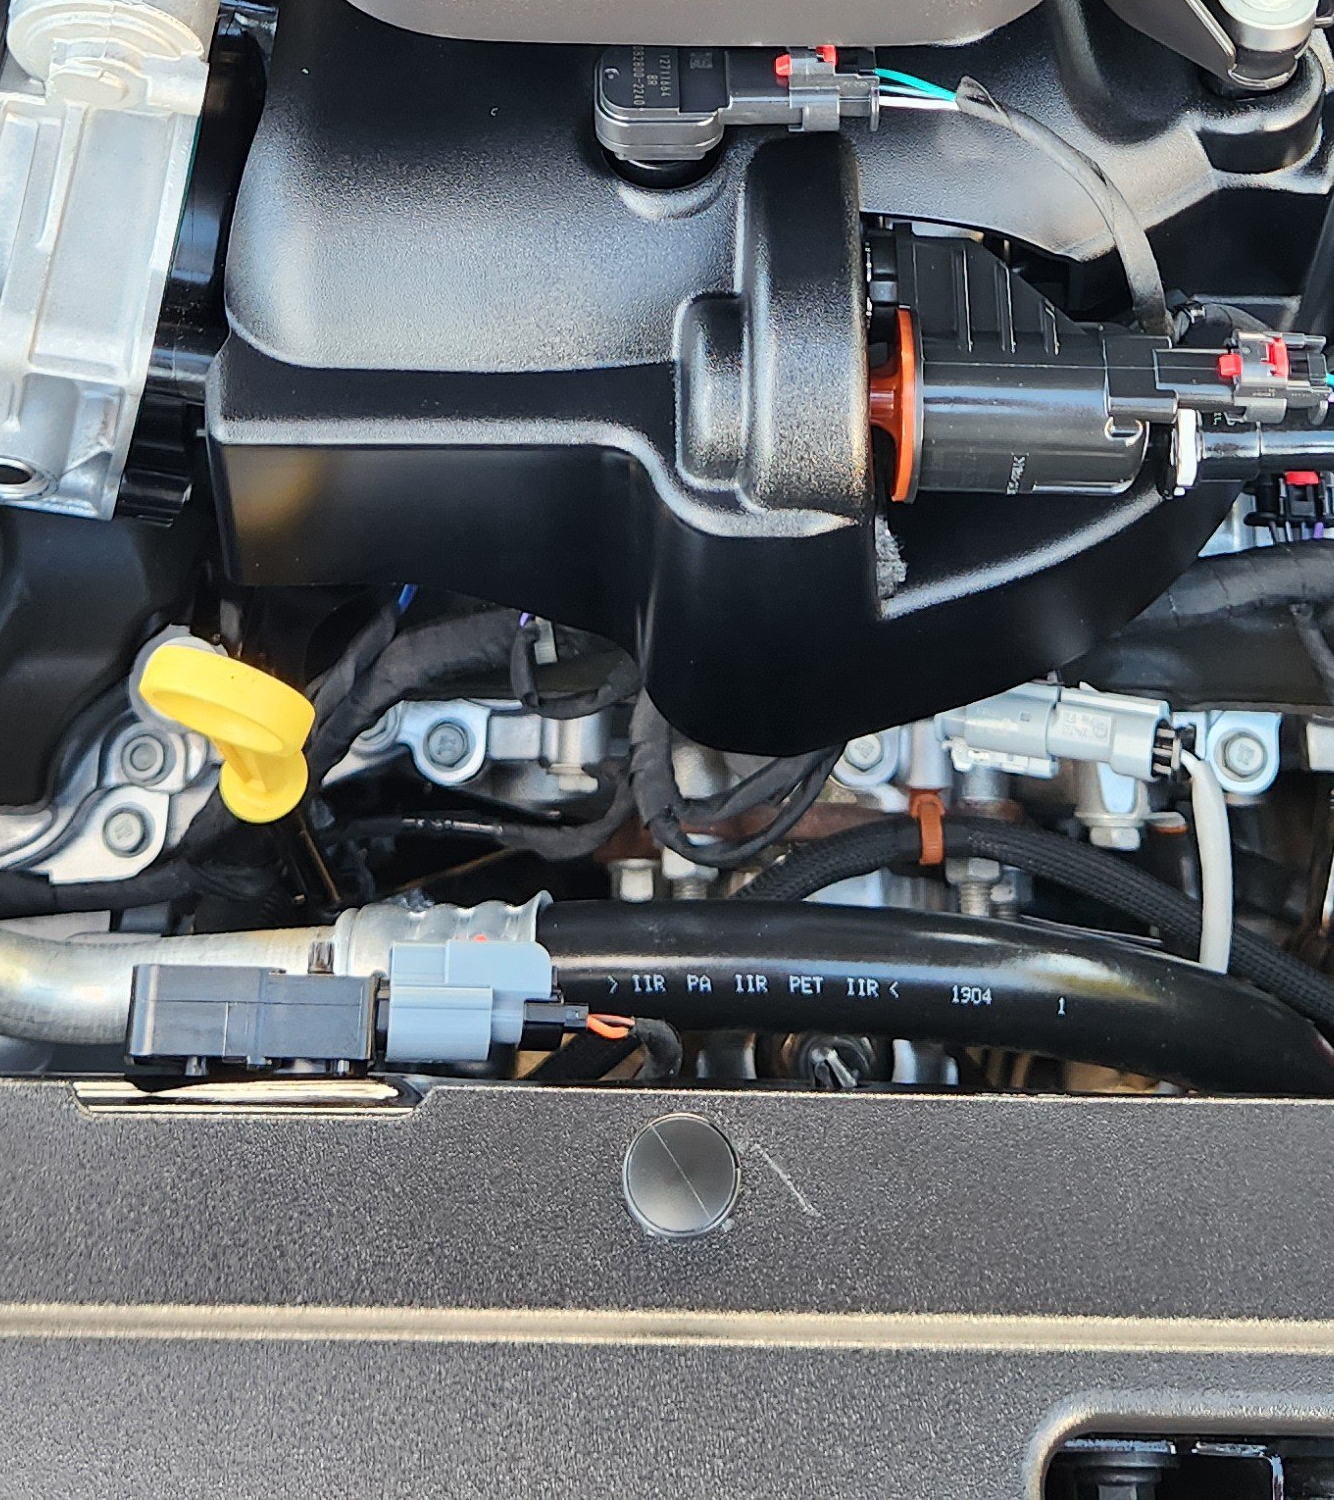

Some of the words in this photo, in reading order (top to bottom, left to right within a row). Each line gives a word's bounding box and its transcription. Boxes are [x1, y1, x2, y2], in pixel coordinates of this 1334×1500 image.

[686, 974, 713, 993] PA
[788, 975, 824, 994] PET
[951, 985, 993, 1006] 1904
